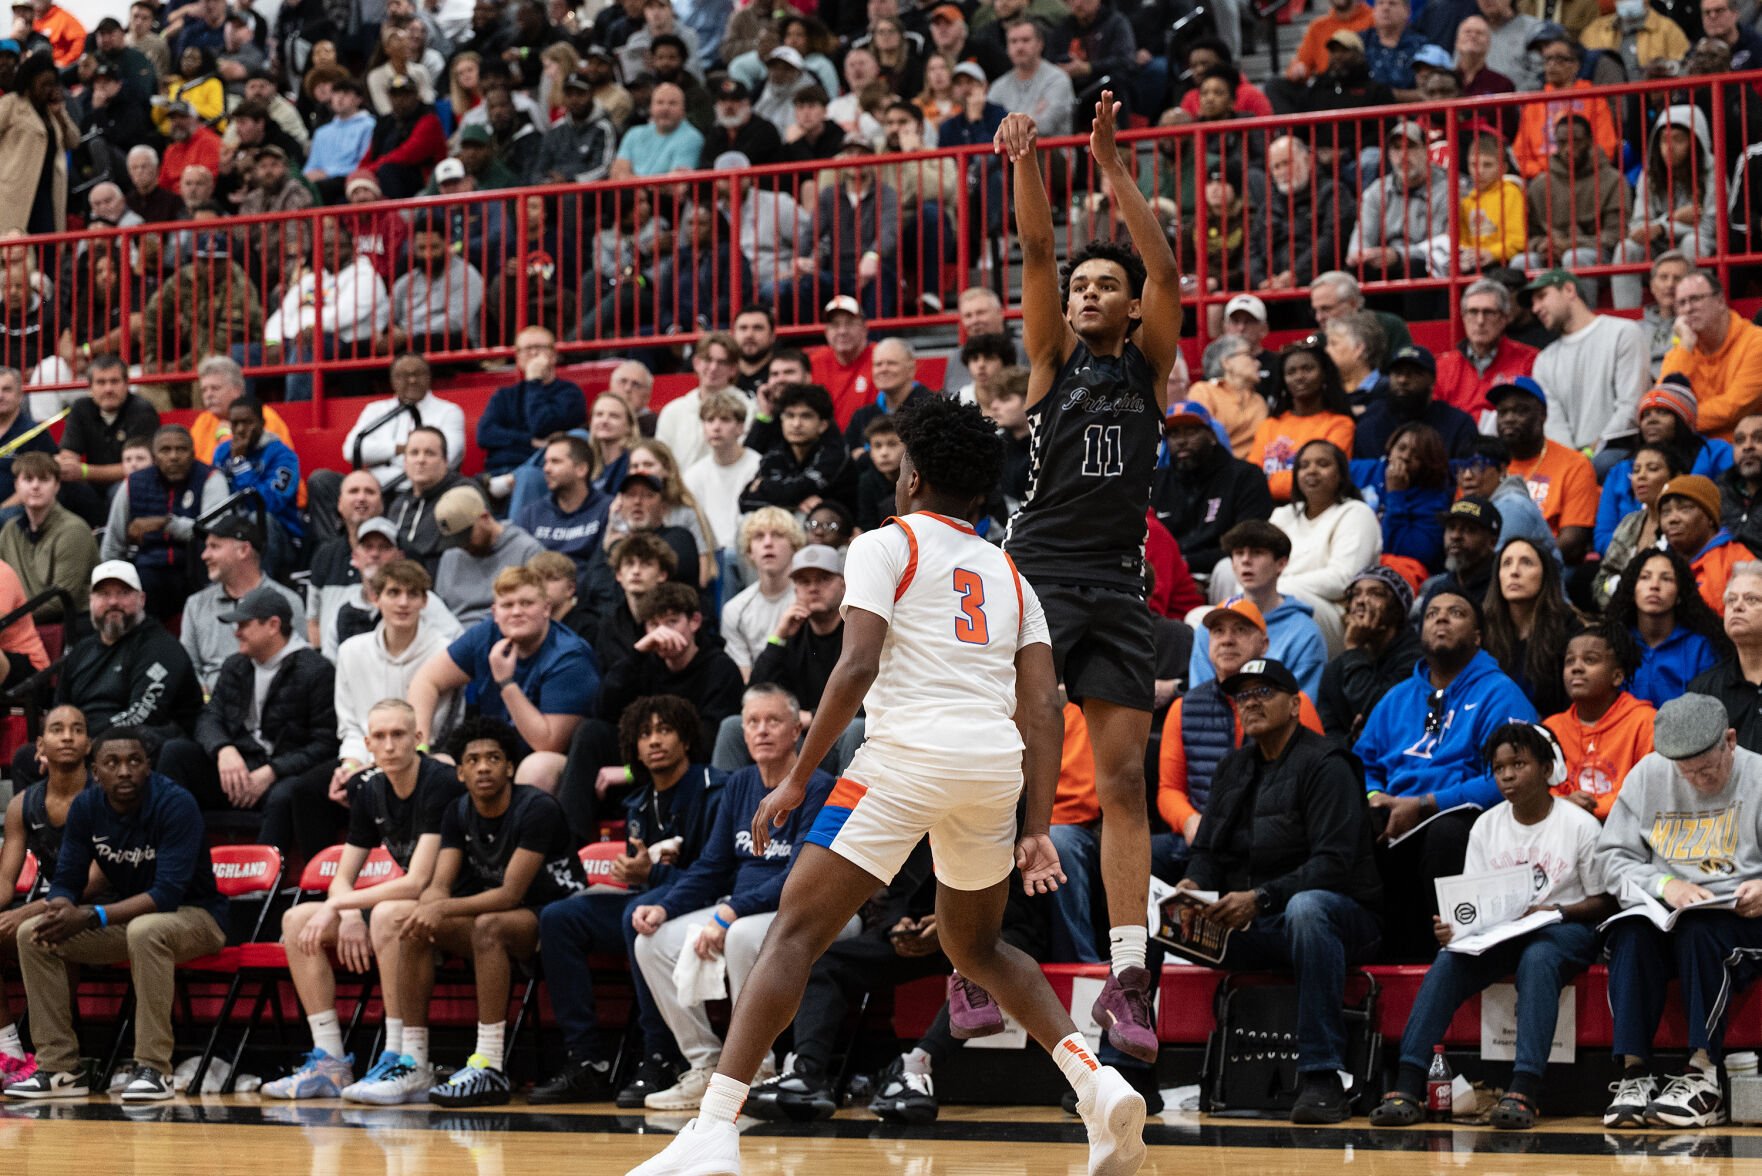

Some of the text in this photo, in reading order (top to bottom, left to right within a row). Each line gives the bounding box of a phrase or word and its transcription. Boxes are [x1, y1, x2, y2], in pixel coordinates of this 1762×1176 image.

[1082, 424, 1123, 476] 11
[270, 465, 292, 492] 3
[953, 567, 989, 645] 3
[212, 861, 267, 878] IGHLAND
[320, 861, 393, 877] HIAND
